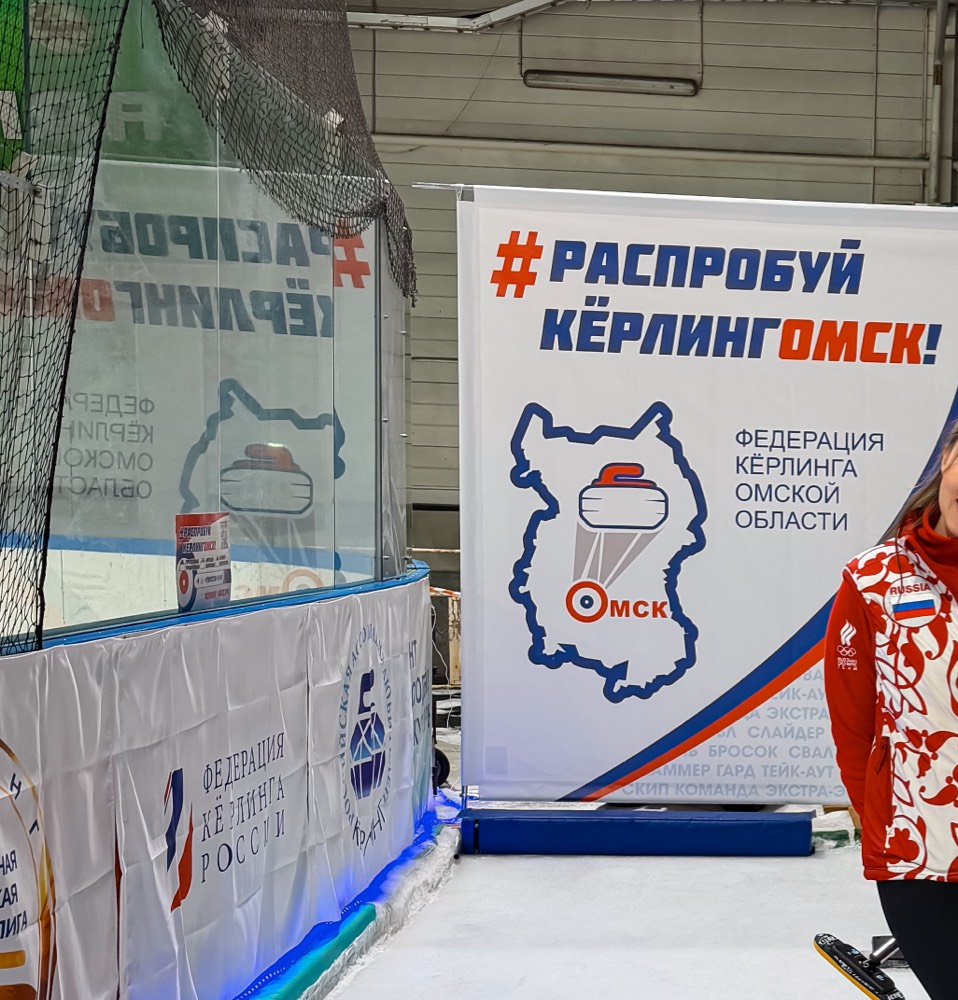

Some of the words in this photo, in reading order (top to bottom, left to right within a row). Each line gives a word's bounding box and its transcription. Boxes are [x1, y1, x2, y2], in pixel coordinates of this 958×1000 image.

[490, 230, 865, 298] #РАСПРОБУЙ
[539, 295, 942, 365] КЁРЛИНГОМСК!
[735, 429, 884, 453] ФЕДЕРАЦИЯ
[735, 456, 858, 478] КЁРЛИНГА
[735, 482, 840, 505] ОМСКОЙ
[735, 510, 848, 532] ОБЛАСТИ
[890, 583, 931, 595] RUSSIA
[748, 723, 824, 741] СЛАЙДЕР
[203, 732, 285, 794] ФЕДЕРАЦИЯ
[709, 745, 778, 758] БРОСОК
[789, 746, 833, 759] СВАЛ
[716, 765, 756, 779] ГАРД
[762, 762, 834, 778] ТЕЙК-АУТ
[622, 783, 669, 796] СКИП
[675, 783, 759, 798] КОМАНДА
[201, 774, 285, 842] КЁРЛИНГА
[201, 810, 285, 884] РОССИИ
